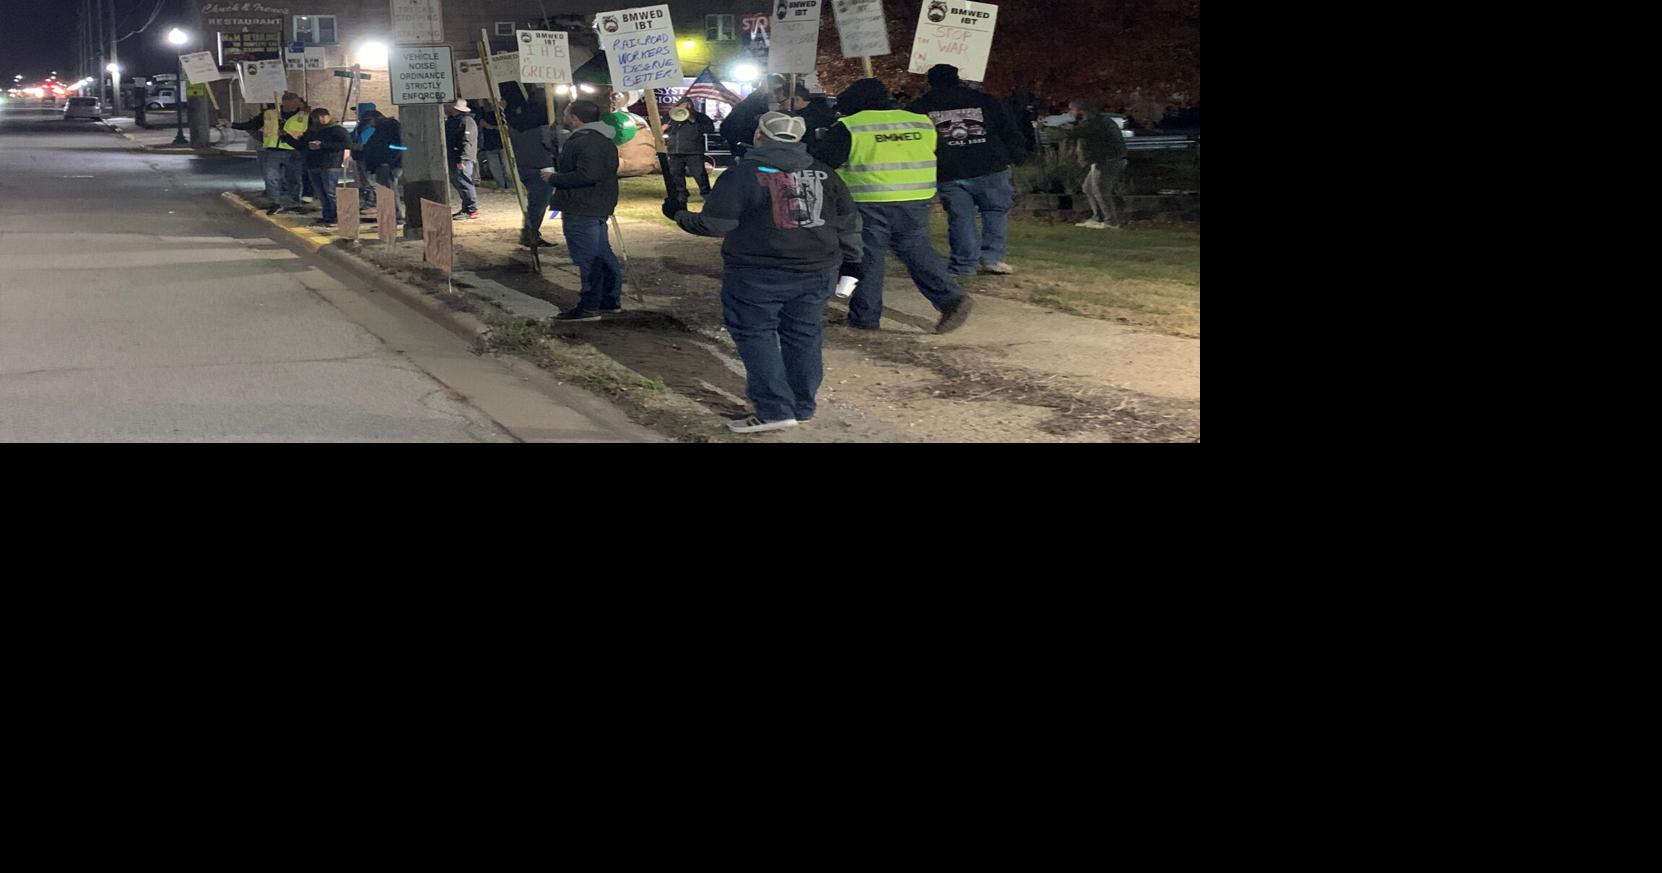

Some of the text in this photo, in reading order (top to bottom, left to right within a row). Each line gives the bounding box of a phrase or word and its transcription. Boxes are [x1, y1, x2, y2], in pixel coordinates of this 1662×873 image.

[622, 9, 664, 22] BMWED
[951, 8, 990, 19] BMWED
[635, 20, 653, 30] IBT
[961, 17, 978, 25] IBT
[933, 27, 972, 41] STOP
[613, 34, 669, 50] RAILROAD
[937, 40, 969, 55] WAR
[403, 53, 440, 61] VEHICLE
[618, 46, 670, 65] WORKERS
[409, 62, 435, 70] NOISE
[623, 59, 674, 74] DESERVE
[400, 72, 446, 80] ORDINANCE
[405, 82, 442, 90] STRICTLY
[402, 92, 446, 100] ENFORCED
[874, 132, 922, 143] BMWED
